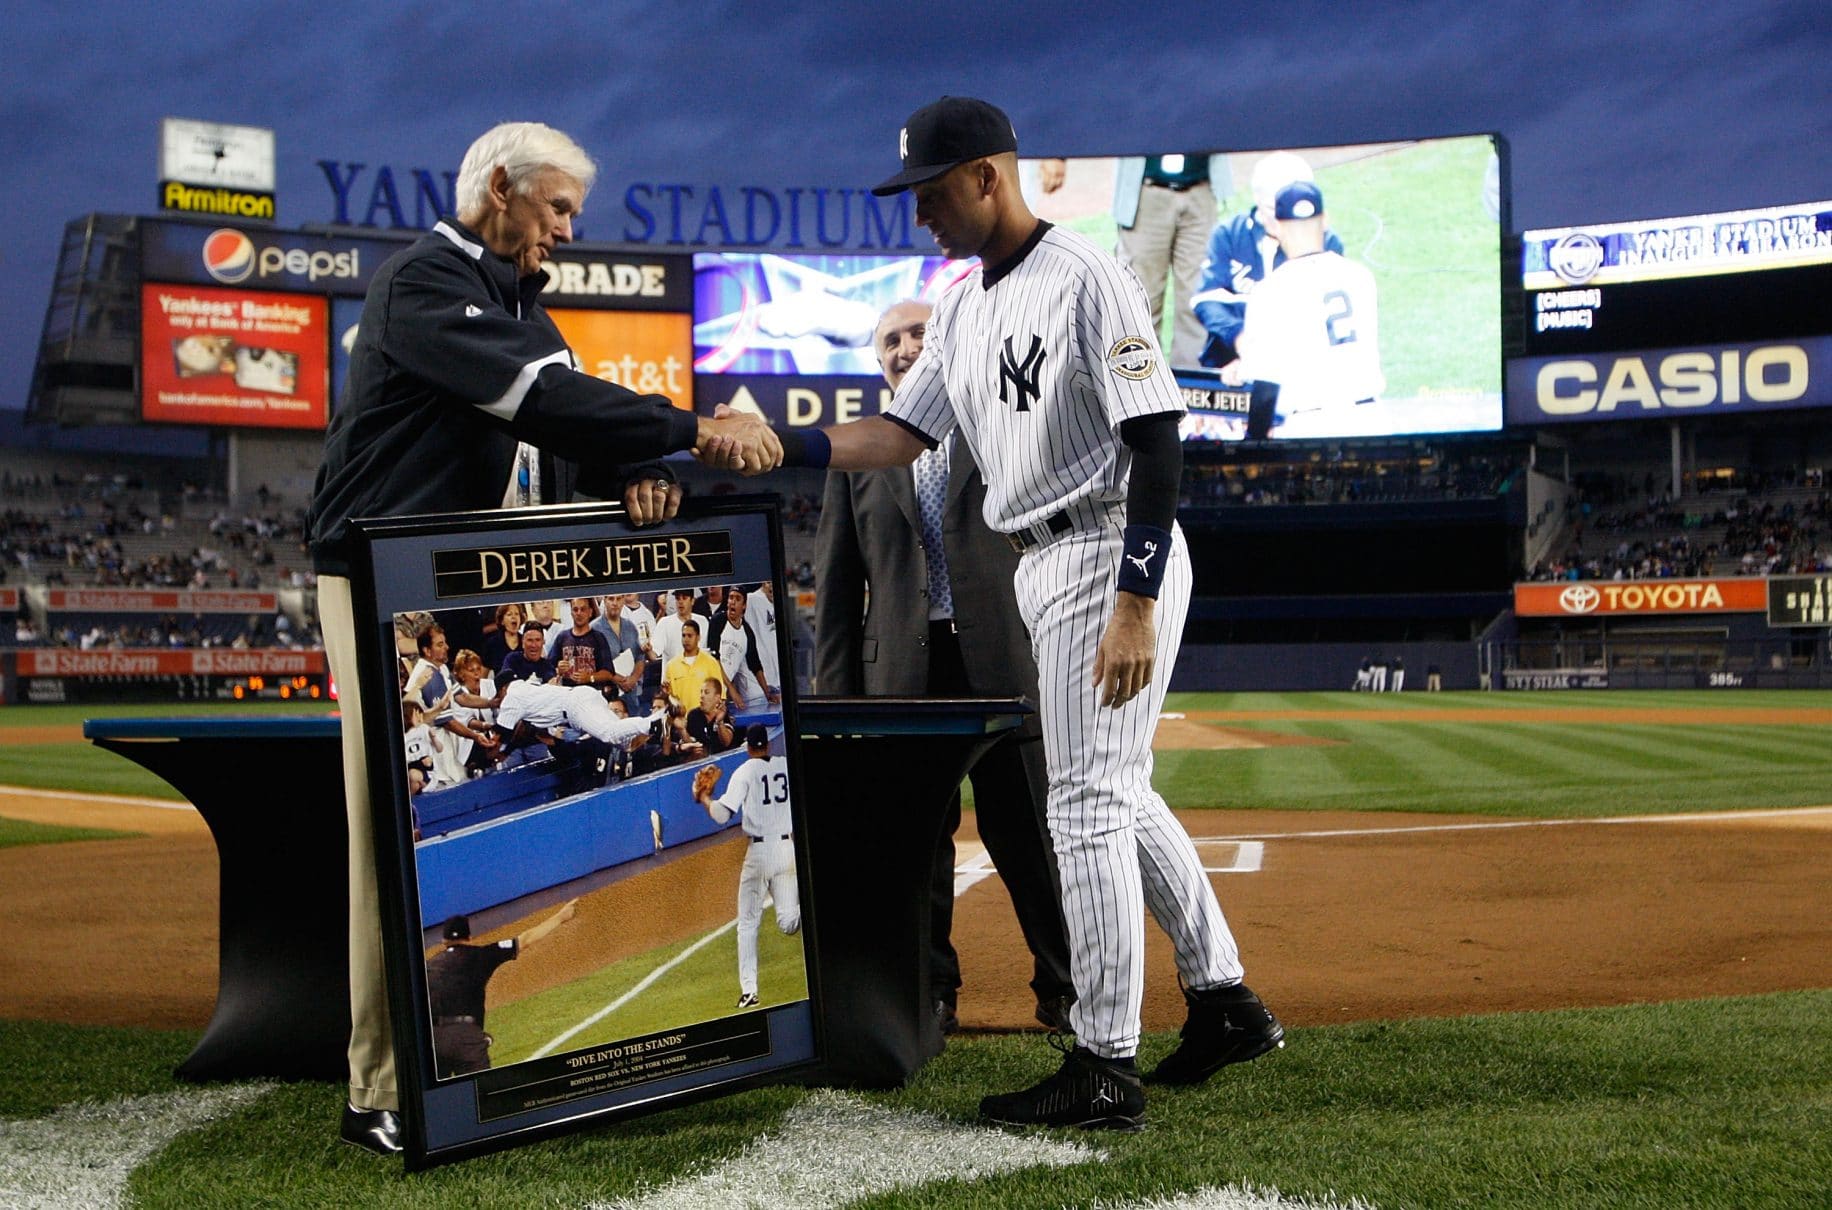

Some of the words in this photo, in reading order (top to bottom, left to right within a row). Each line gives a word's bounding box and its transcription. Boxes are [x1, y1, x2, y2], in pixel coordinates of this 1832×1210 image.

[165, 181, 274, 218] Armitron
[624, 183, 914, 248] STADIUM
[1719, 215, 1818, 244] STADIUM
[260, 248, 359, 282] pepsi
[540, 261, 665, 296] ORADE
[195, 317, 209, 328] at
[210, 317, 239, 329] Bank
[241, 318, 253, 330] of
[254, 322, 301, 334] America
[241, 300, 311, 326] Banking
[1323, 290, 1357, 346] 2
[597, 353, 682, 394] at&t
[999, 334, 1047, 412] NY
[1537, 345, 1811, 416] CASIO
[787, 388, 894, 426] DEL
[1145, 541, 1157, 551] 2
[478, 547, 594, 590] DEREK
[602, 537, 697, 577] JETER
[1605, 584, 1723, 610] TOYOTA
[761, 773, 788, 805] 13
[597, 1049, 622, 1062] INTO
[623, 1043, 645, 1056] THE
[570, 1075, 594, 1087] BOSTON
[594, 1072, 607, 1082] RED
[607, 1069, 620, 1079] SOX
[631, 1064, 644, 1074] NEW
[645, 1060, 661, 1070] YORK
[662, 1054, 687, 1067] YANKEES
